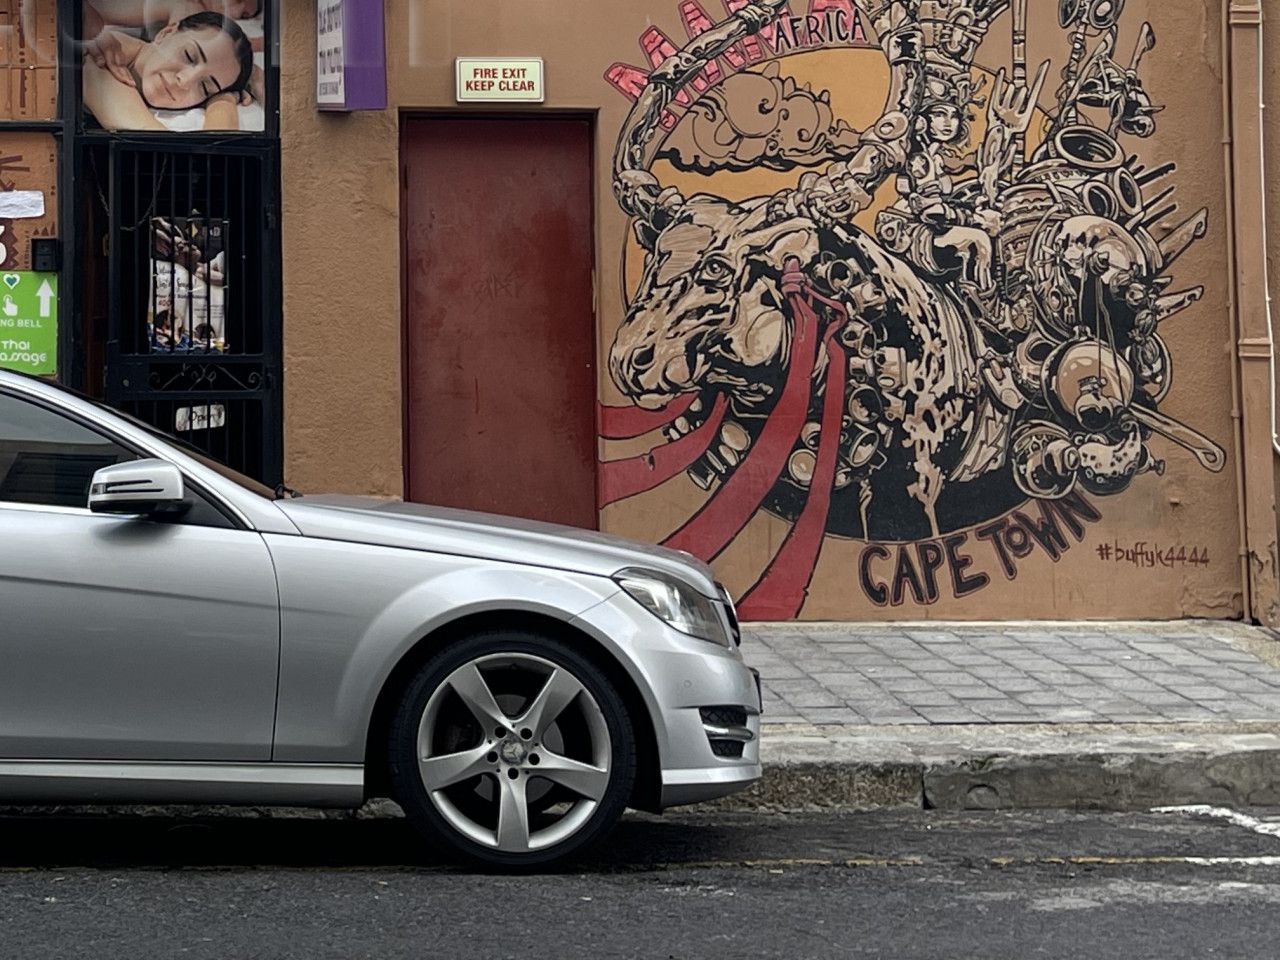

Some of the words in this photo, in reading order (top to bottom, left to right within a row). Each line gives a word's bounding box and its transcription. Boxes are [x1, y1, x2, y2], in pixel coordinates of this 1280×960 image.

[773, 8, 869, 53] AFRICA
[473, 68, 498, 79] FIRE
[502, 68, 527, 79] EXIT
[465, 80, 495, 91] KEEP
[498, 80, 535, 91] CLEAR
[17, 318, 42, 328] BELL
[1, 339, 30, 350] Thai
[858, 534, 991, 607] CAPE
[975, 487, 1103, 581] TOWN
